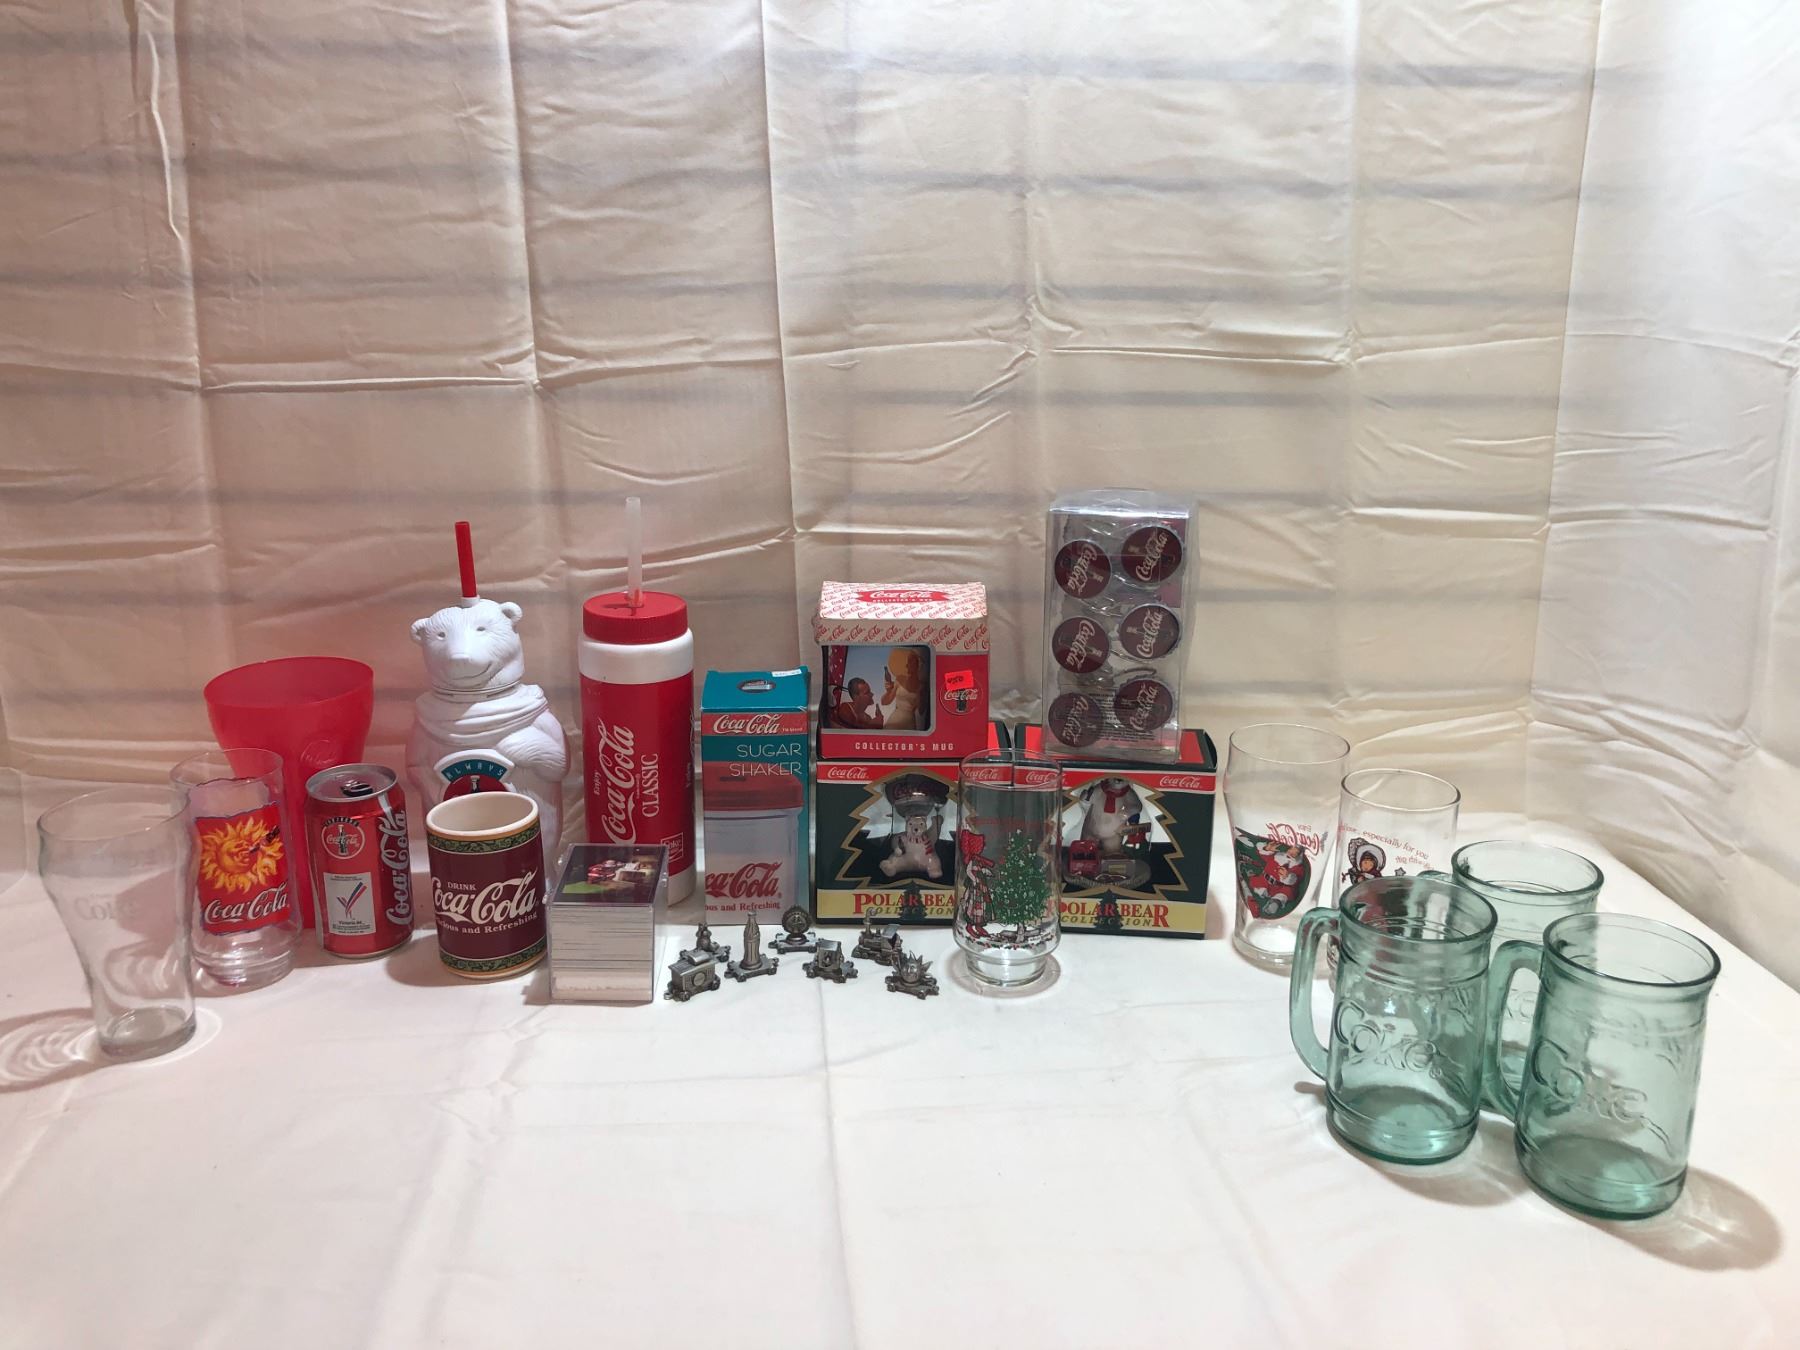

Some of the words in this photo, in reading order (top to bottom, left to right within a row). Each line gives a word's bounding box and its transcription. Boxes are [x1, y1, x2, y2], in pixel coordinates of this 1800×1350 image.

[713, 714, 782, 734] Coca-Cola
[736, 743, 802, 758] SUGAR
[855, 742, 926, 751] COLLECTOR'S
[932, 743, 954, 751] MUG
[446, 763, 504, 778] ALWAYS
[729, 762, 803, 777] SHAKER
[827, 766, 869, 780] Coca-Cola
[598, 717, 636, 845] Coca-Cola
[640, 753, 660, 818] CLASSIC
[1159, 776, 1201, 789] Coca-Cola
[1362, 830, 1403, 849] especially
[1402, 842, 1416, 853] for
[378, 808, 414, 926] Coca-Cola
[431, 867, 538, 925] Coca-Cola
[447, 881, 477, 891] DRINK
[205, 881, 289, 925] Coca-Cola
[720, 903, 736, 911] and
[852, 893, 920, 915] POLAR
[923, 893, 956, 907] BEA
[484, 911, 538, 934] Refreshing
[1118, 903, 1170, 928] BEAR
